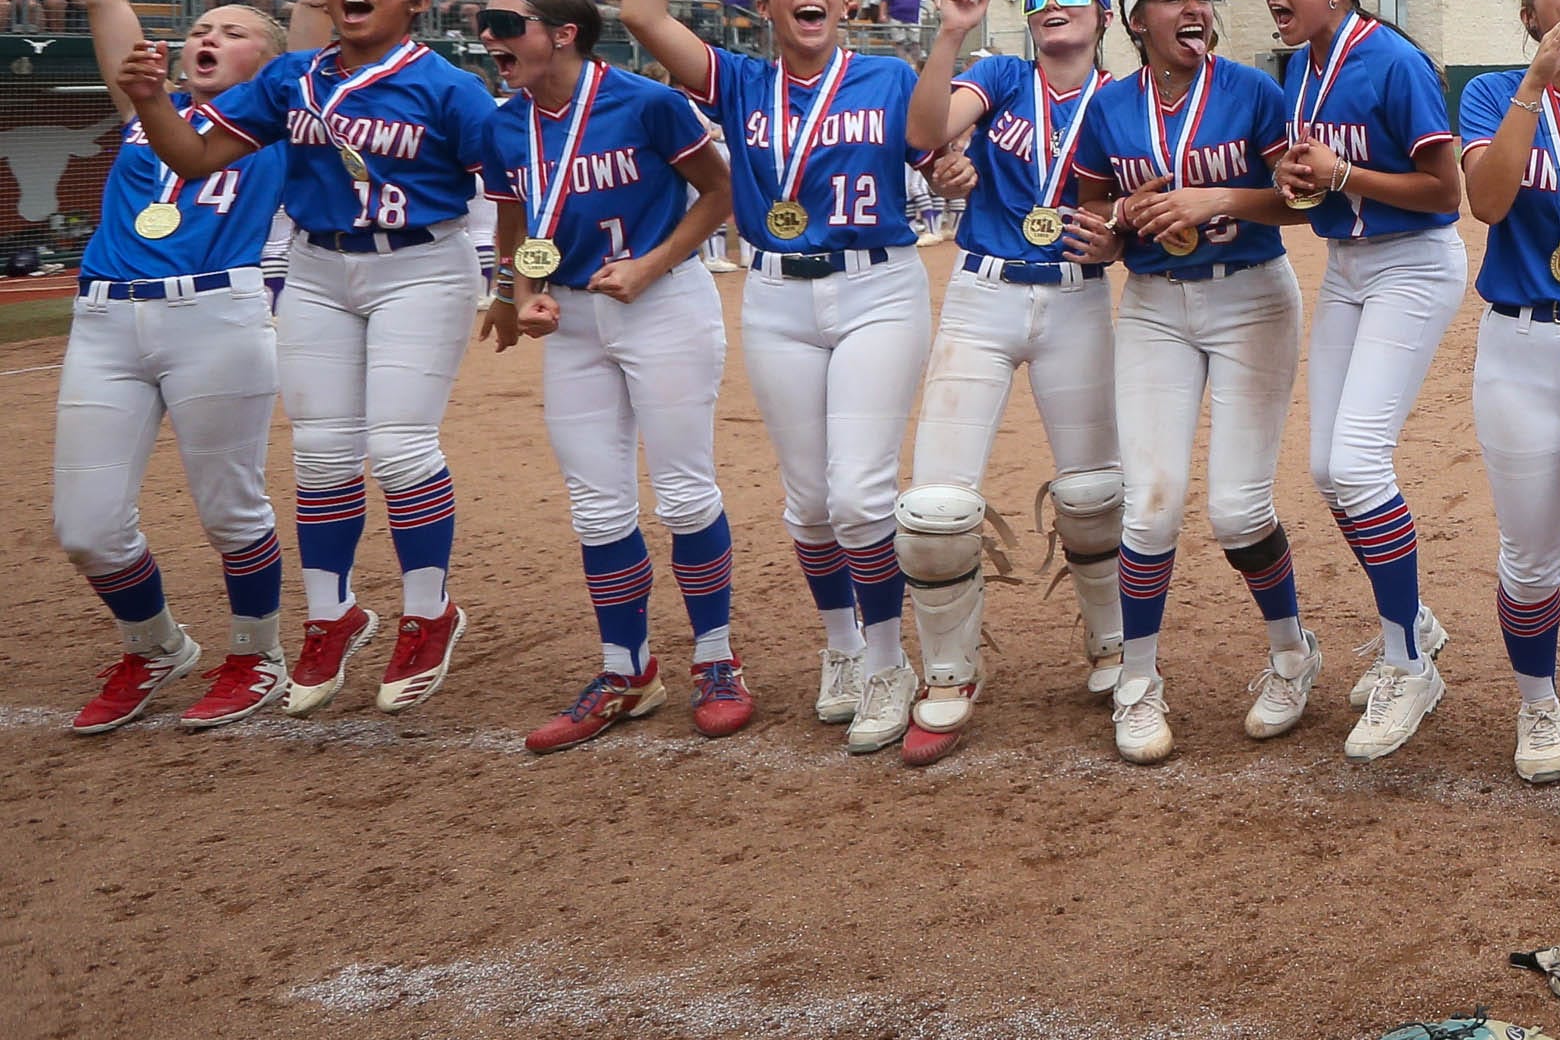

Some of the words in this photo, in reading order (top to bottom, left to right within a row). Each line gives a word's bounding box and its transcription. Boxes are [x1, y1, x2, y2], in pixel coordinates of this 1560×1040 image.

[197, 169, 240, 214] 4
[352, 179, 408, 230] 18
[828, 173, 879, 226] 12
[599, 216, 633, 264] 1
